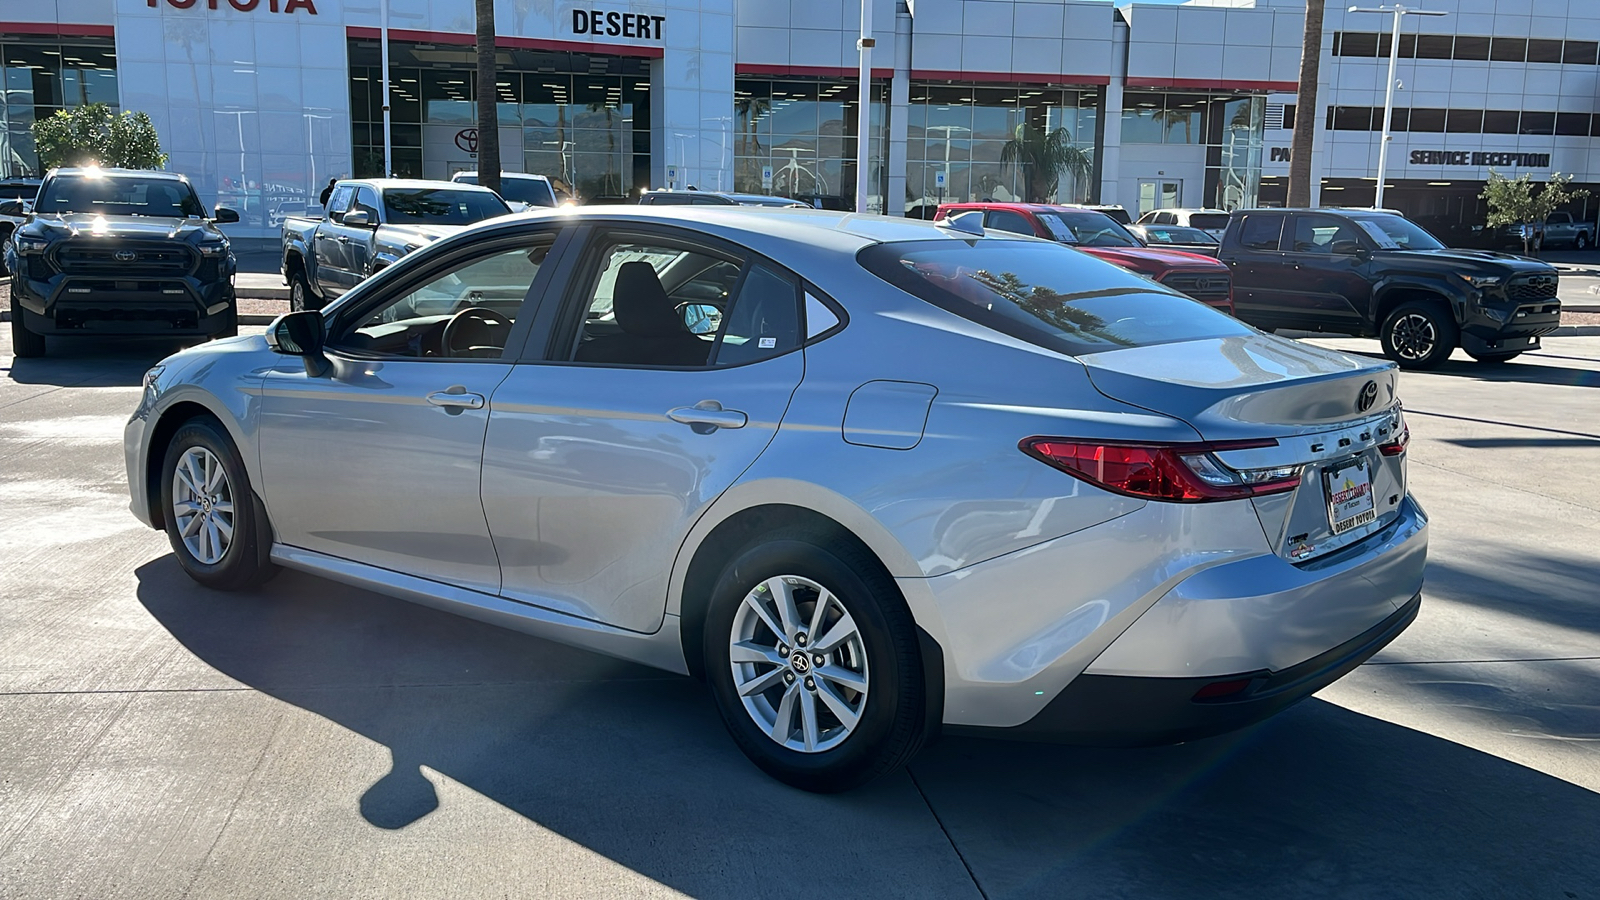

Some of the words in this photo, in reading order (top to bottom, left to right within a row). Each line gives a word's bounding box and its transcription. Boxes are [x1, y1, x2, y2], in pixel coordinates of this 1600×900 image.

[572, 9, 665, 40] DESERT
[1410, 150, 1470, 165] SERVICE
[1471, 151, 1550, 167] RECEPTION
[1332, 490, 1349, 505] DESERT
[1335, 517, 1355, 533] DESERT
[1356, 510, 1375, 525] TOYOTA
